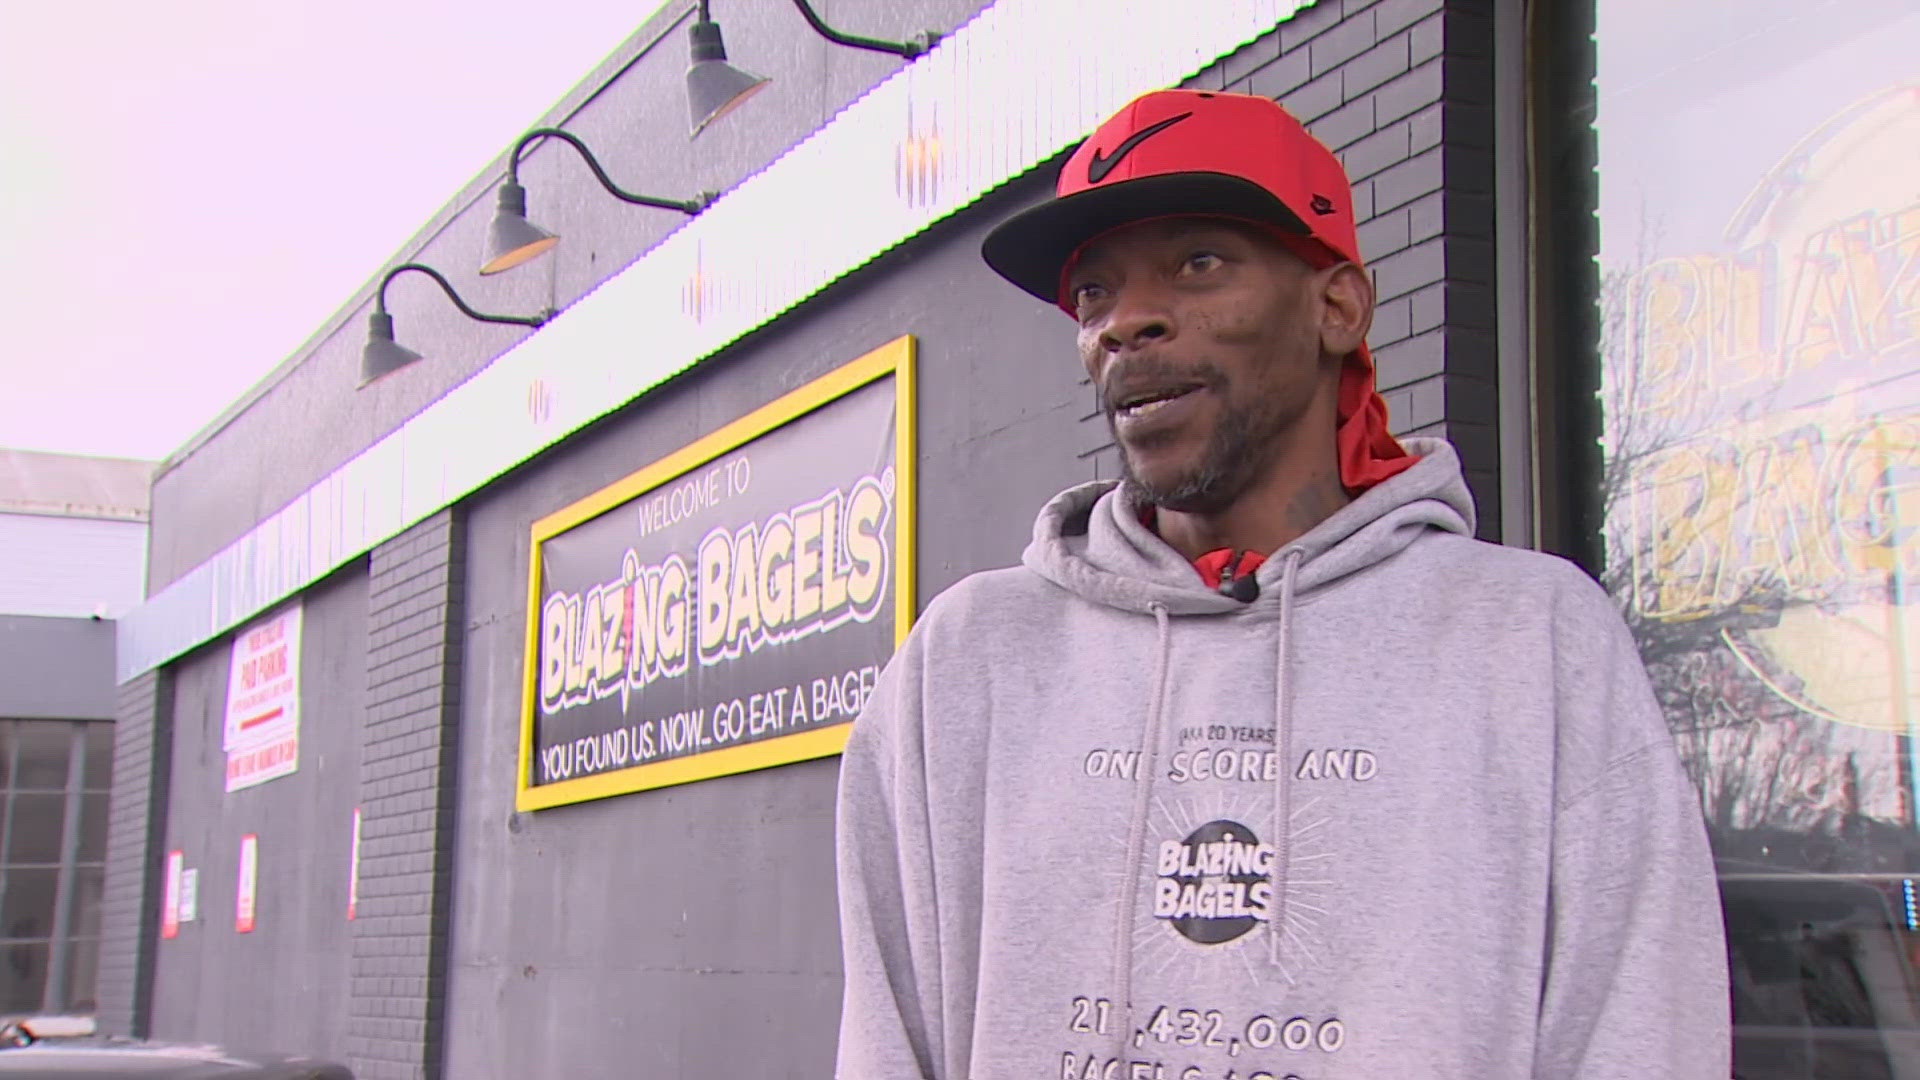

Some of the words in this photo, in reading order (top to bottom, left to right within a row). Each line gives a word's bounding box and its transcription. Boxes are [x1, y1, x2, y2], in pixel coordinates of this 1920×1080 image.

[638, 468, 721, 537] WELCOME
[724, 456, 750, 497] TO
[541, 743, 573, 781] YOU
[575, 728, 629, 774] FOUND
[631, 720, 656, 761] US.
[713, 697, 747, 744] GO
[749, 687, 788, 735] EAT
[790, 684, 808, 727] A
[1207, 724, 1226, 741] 20
[1168, 748, 1279, 784] SCORE
[1296, 749, 1378, 781] AND
[1153, 878, 1274, 923] BAGELS
[1070, 995, 1345, 1056] 21,432,000
